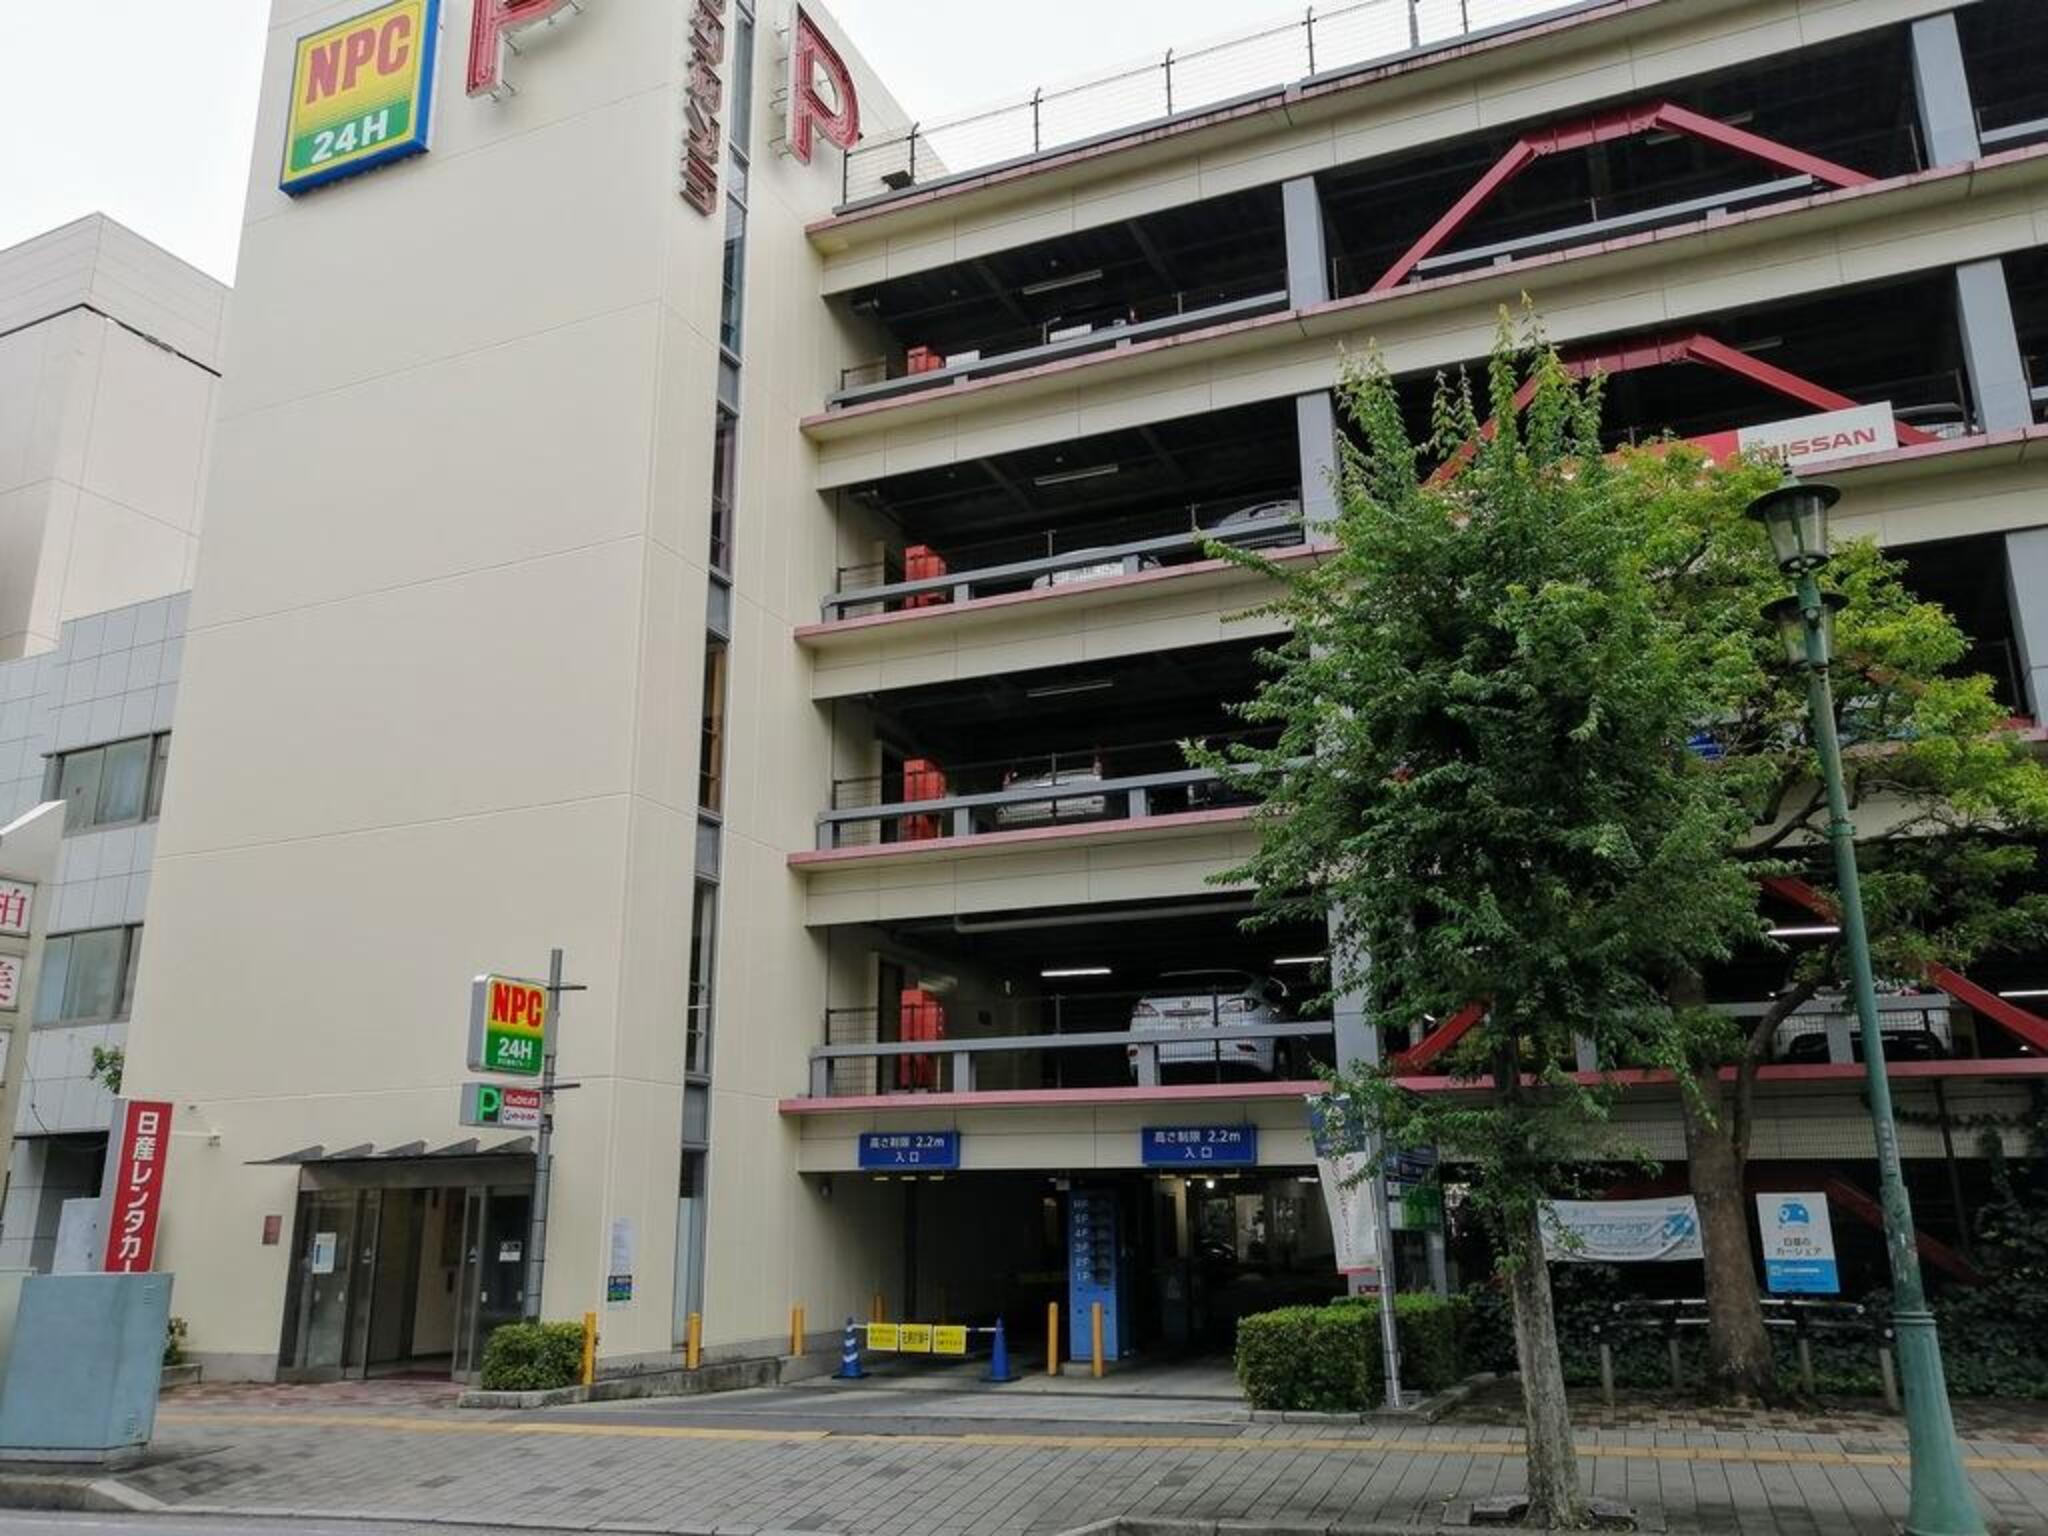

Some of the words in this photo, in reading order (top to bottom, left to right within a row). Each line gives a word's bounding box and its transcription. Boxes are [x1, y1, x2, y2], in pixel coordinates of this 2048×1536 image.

[305, 13, 411, 105] NPC
[788, 3, 859, 165] P
[311, 108, 390, 165] 24H
[1758, 427, 1877, 461] NISSAN
[491, 981, 542, 1028] NPC
[498, 1037, 533, 1060] 24H
[478, 1087, 500, 1121] P
[869, 1136, 911, 1149] 高さ制限
[915, 1135, 945, 1149] 2.2m
[1154, 1130, 1201, 1143] 高さ制限
[1207, 1129, 1241, 1143] 2.2m
[118, 1110, 160, 1274] 日産レンタカー
